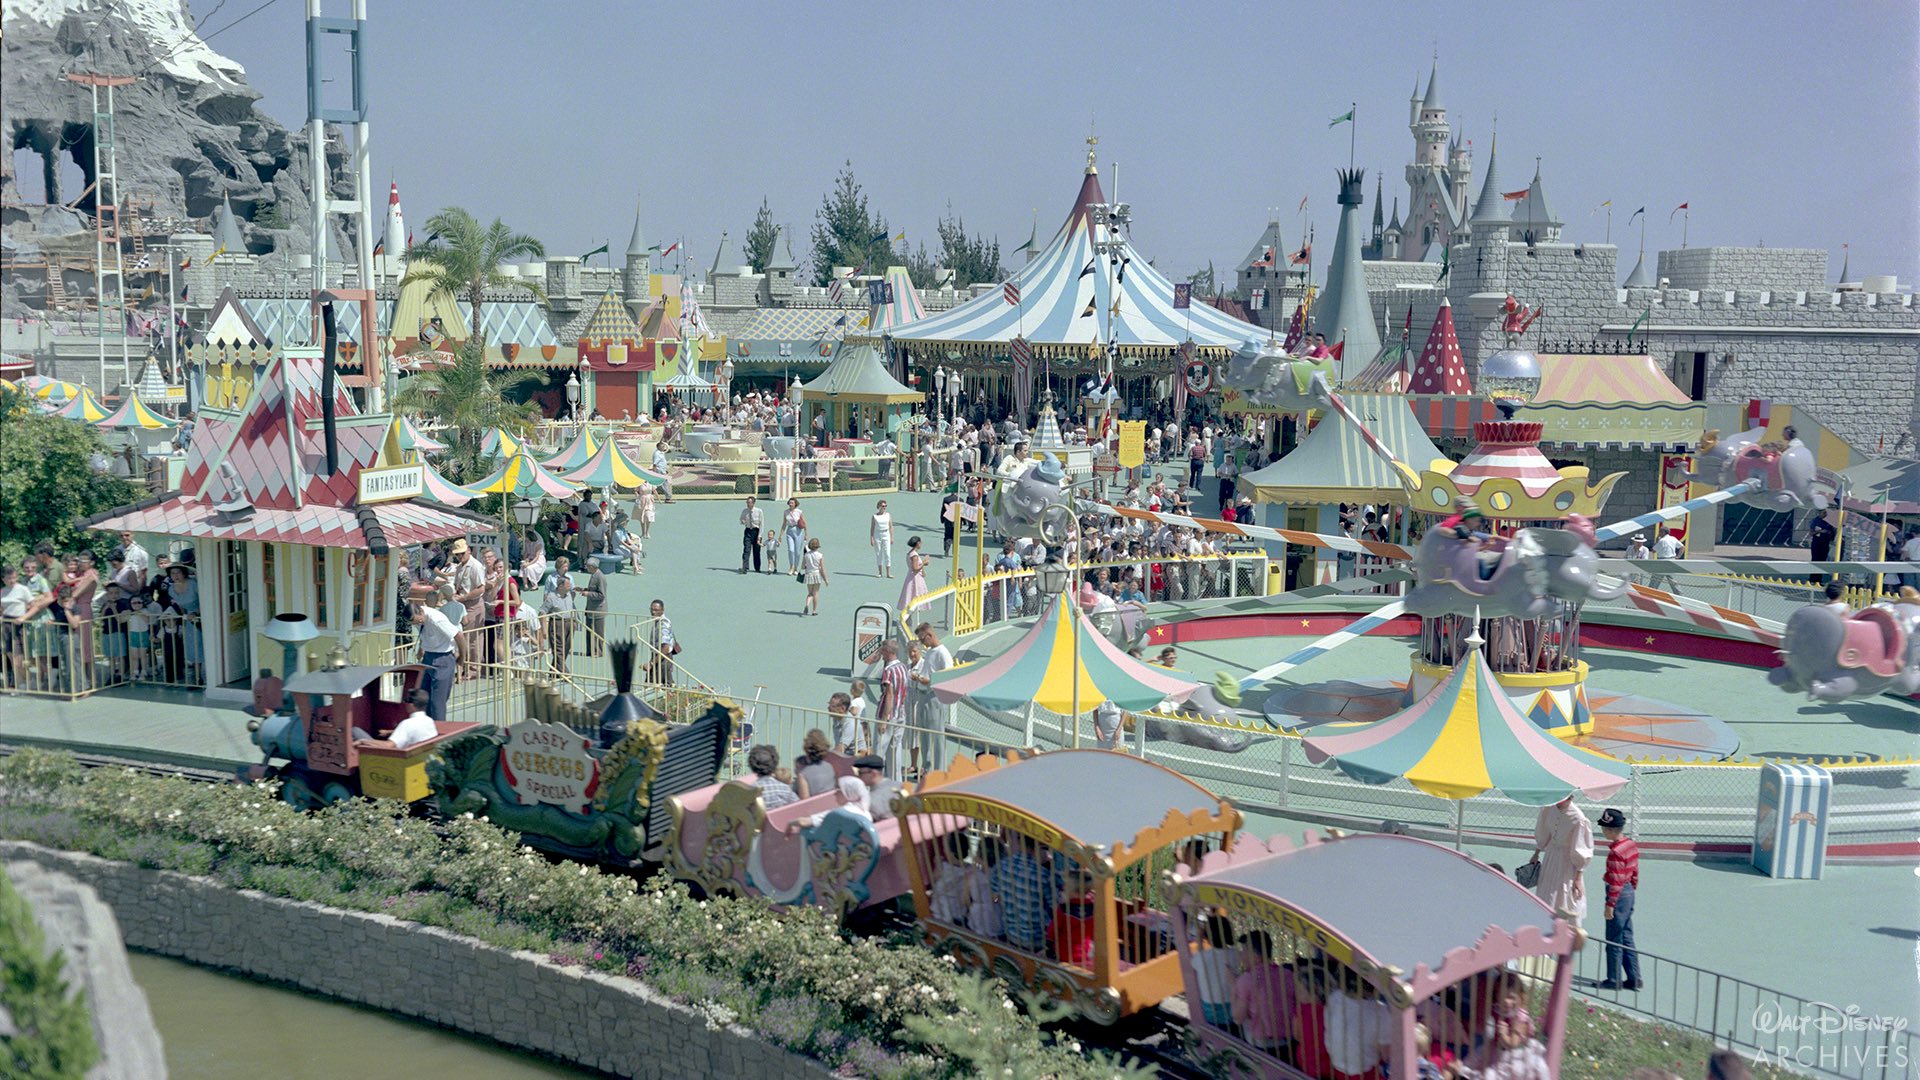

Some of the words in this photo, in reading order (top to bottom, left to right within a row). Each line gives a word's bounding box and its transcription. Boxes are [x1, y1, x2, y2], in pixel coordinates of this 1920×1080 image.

[366, 472, 418, 494] FANTASYLAND
[470, 535, 497, 545] EXIT
[523, 731, 569, 750] CASEY
[513, 751, 585, 781] CIRCUS
[526, 778, 577, 799] SPECIAL
[930, 798, 968, 814] WILD
[976, 801, 1053, 844] ANIMALS
[1214, 888, 1329, 948] MONKEYS
